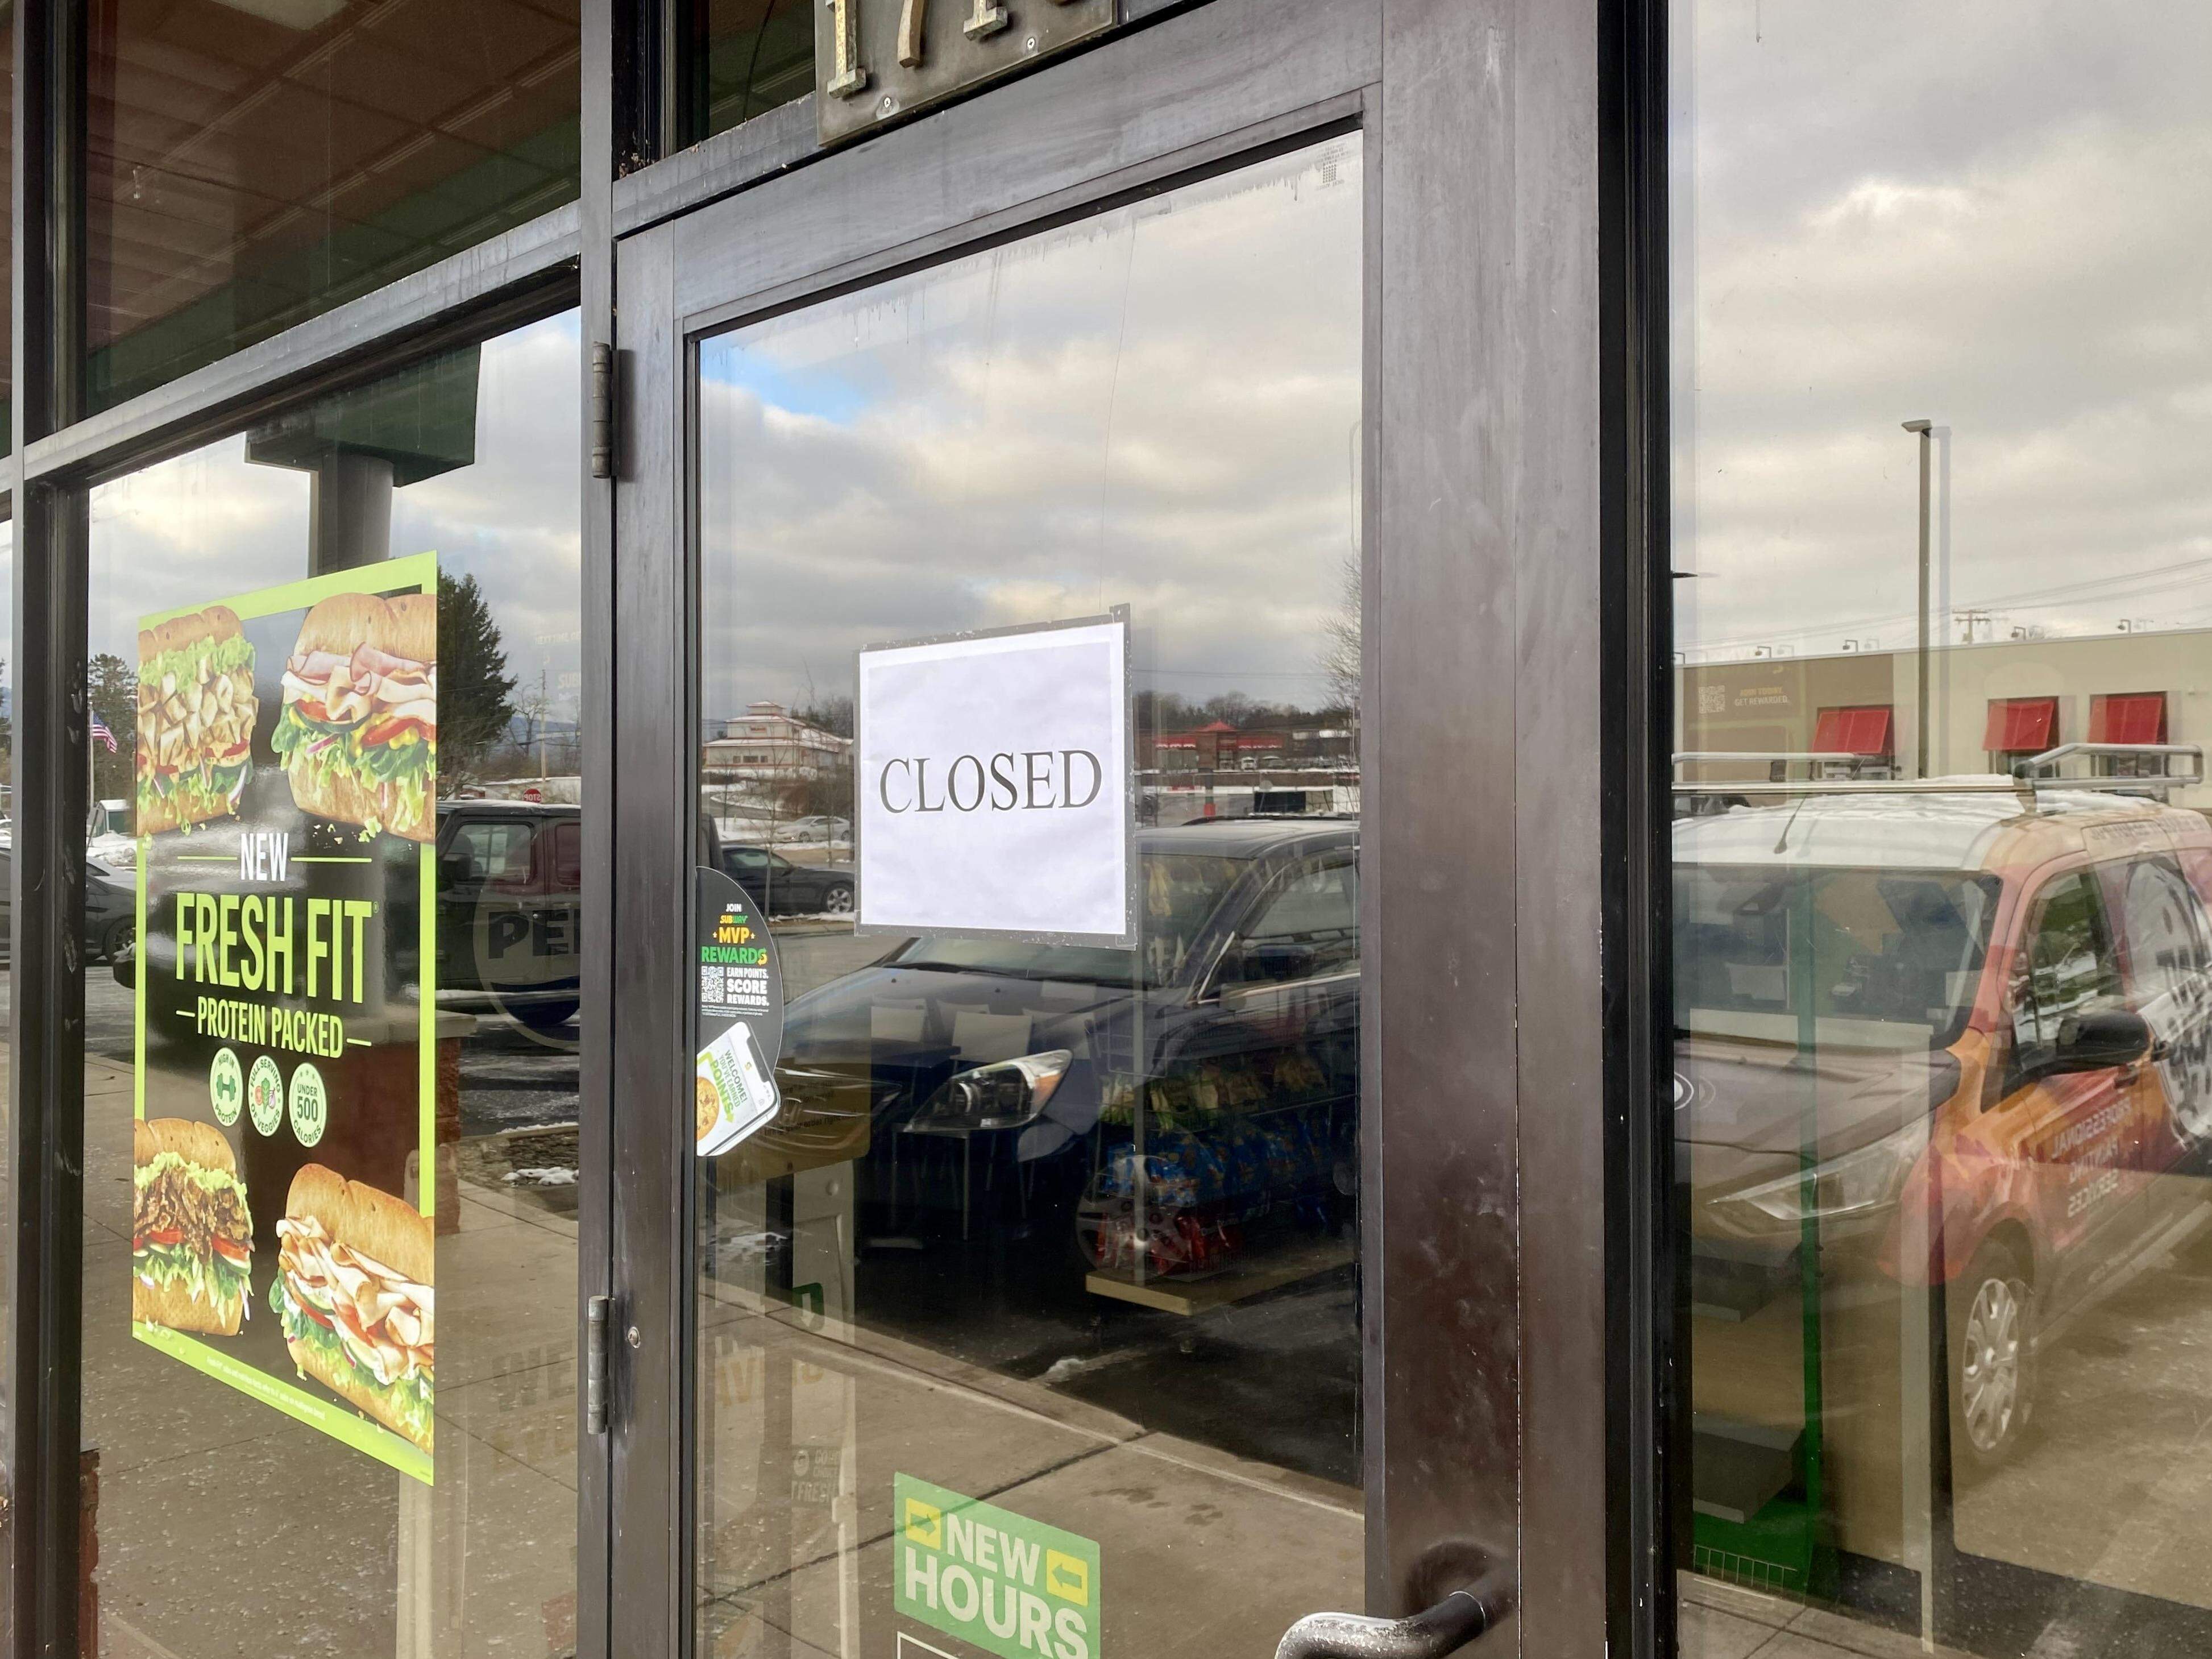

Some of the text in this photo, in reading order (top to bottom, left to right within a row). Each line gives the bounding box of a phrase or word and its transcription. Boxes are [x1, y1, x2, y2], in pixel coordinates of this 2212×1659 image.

[879, 750, 1102, 814] CLOSED
[240, 832, 289, 881] NEW
[726, 903, 742, 912] JOIN
[176, 892, 293, 994] FRESH
[719, 927, 750, 944] MVP
[702, 946, 767, 966] REWARDS
[727, 967, 769, 979] EARN POINTS.
[727, 979, 767, 994] SCORE
[727, 994, 769, 1006] REWARDS.
[197, 996, 343, 1059] PROTEIN PACKED
[218, 1054, 229, 1066] HIGH
[250, 1059, 281, 1093] FULL SERVING
[711, 1060, 733, 1111] POINTS
[724, 1049, 748, 1104] WELCOME!
[297, 1084, 317, 1097] UNDER
[727, 1079, 740, 1108] EARNED
[215, 1103, 237, 1123] PROTEIN
[251, 1103, 280, 1133] OF VEGGIES
[297, 1096, 318, 1122] 500
[293, 1119, 321, 1144] CALORIES
[947, 1512, 1040, 1586] NEW
[905, 1546, 1089, 1659] HOURS
